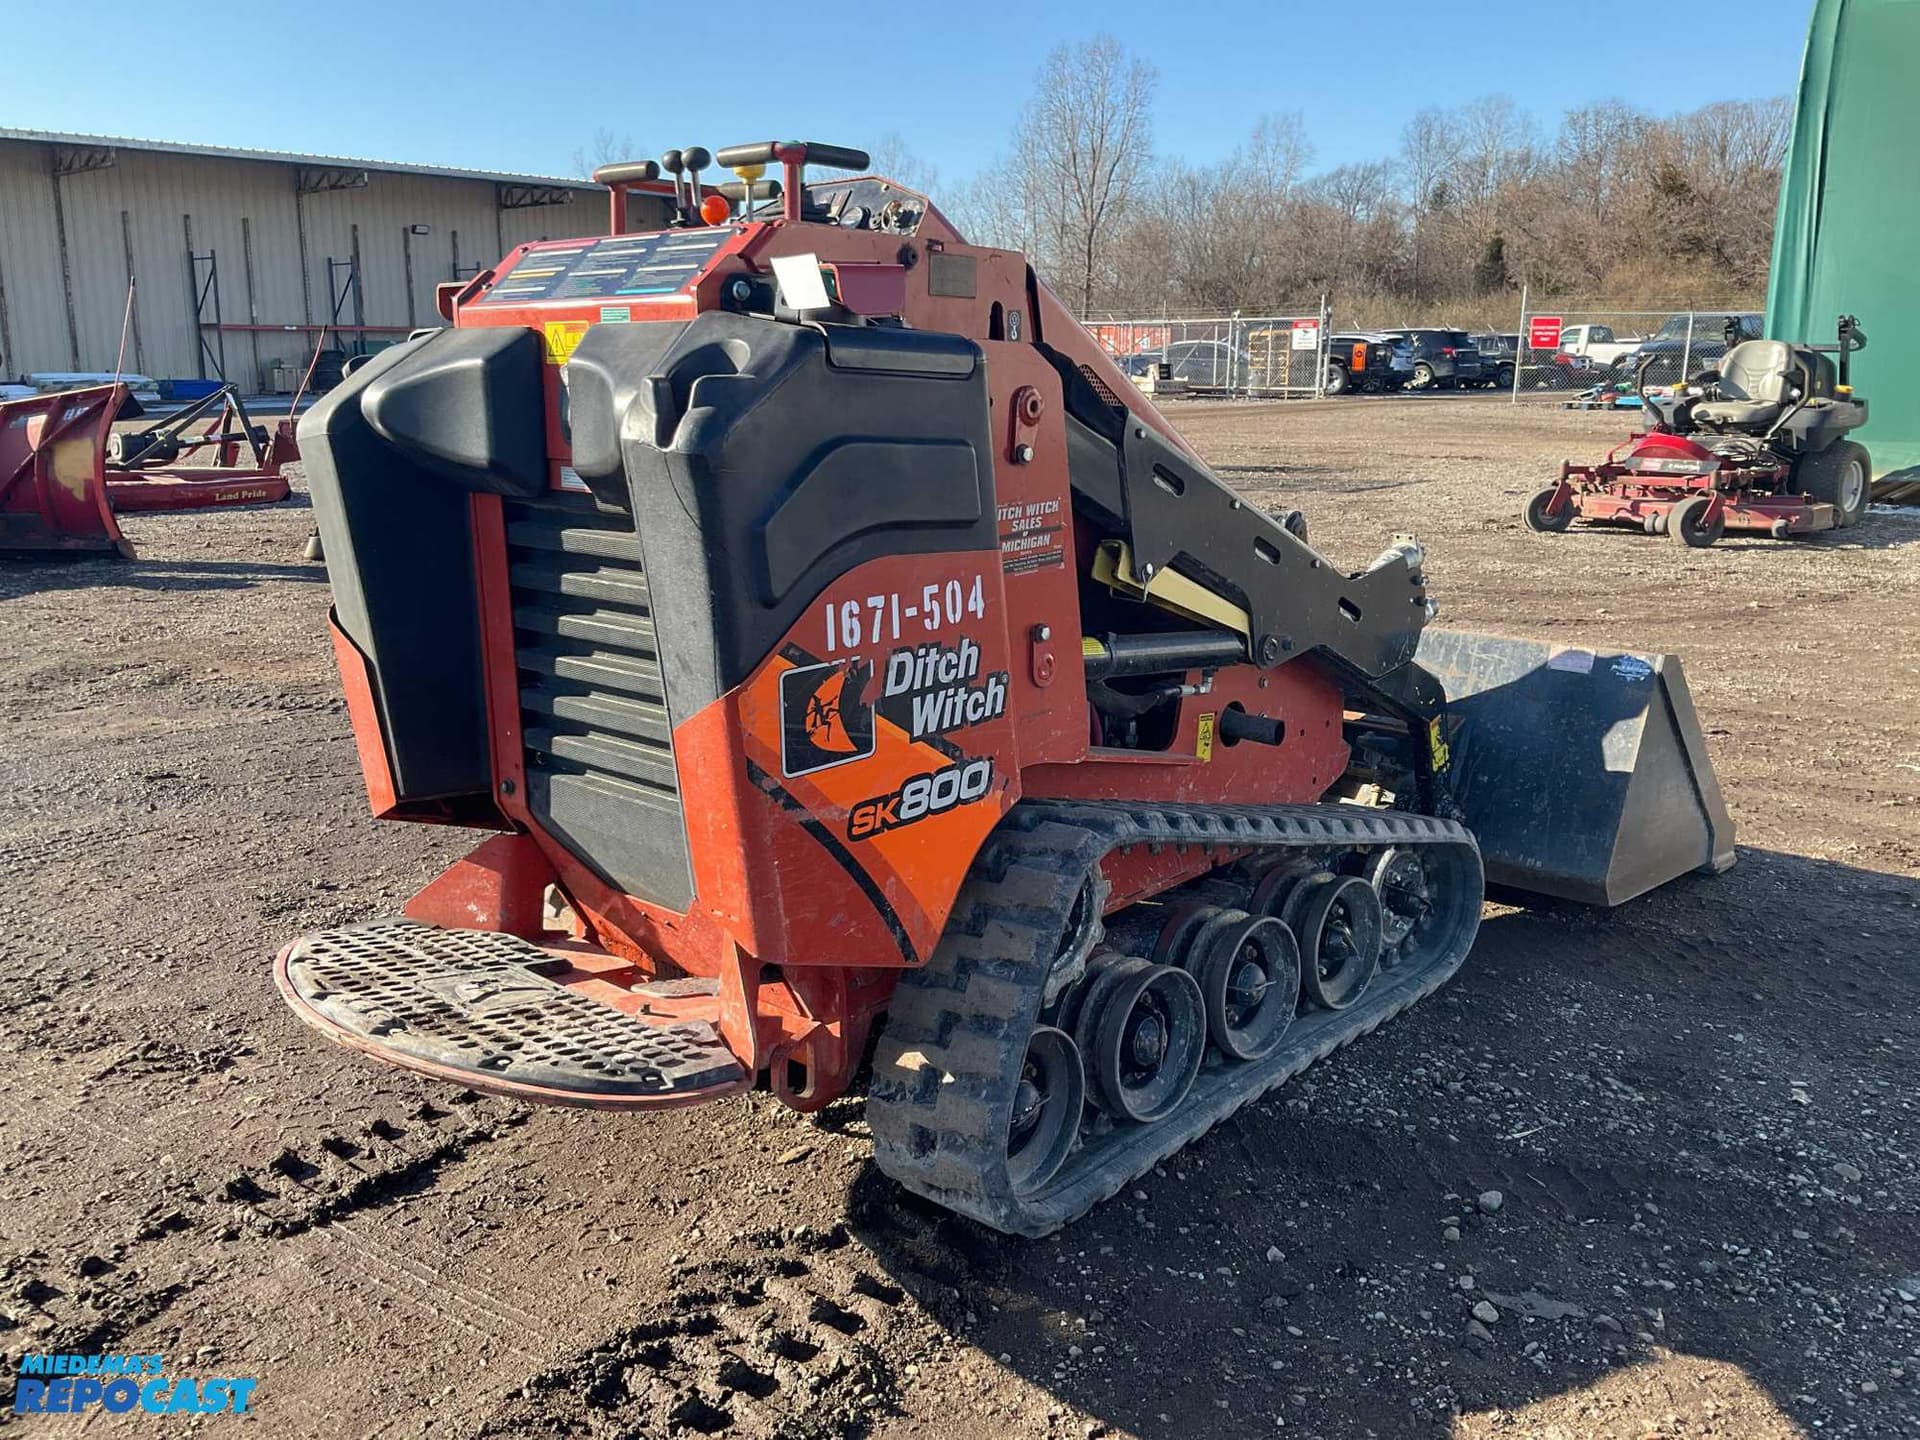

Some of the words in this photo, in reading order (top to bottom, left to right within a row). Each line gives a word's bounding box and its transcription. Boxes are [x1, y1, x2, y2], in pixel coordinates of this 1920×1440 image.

[215, 491, 239, 501] Land
[241, 489, 267, 499] Pride
[997, 505, 1023, 521] ITCH
[1026, 500, 1060, 517] WITCH
[1001, 533, 1051, 553] MICHIGAN
[1011, 516, 1043, 532] SALES
[825, 574, 985, 652] 1671-504
[885, 637, 979, 697] Ditch
[912, 675, 1006, 737] Witch
[850, 759, 992, 837] SK800
